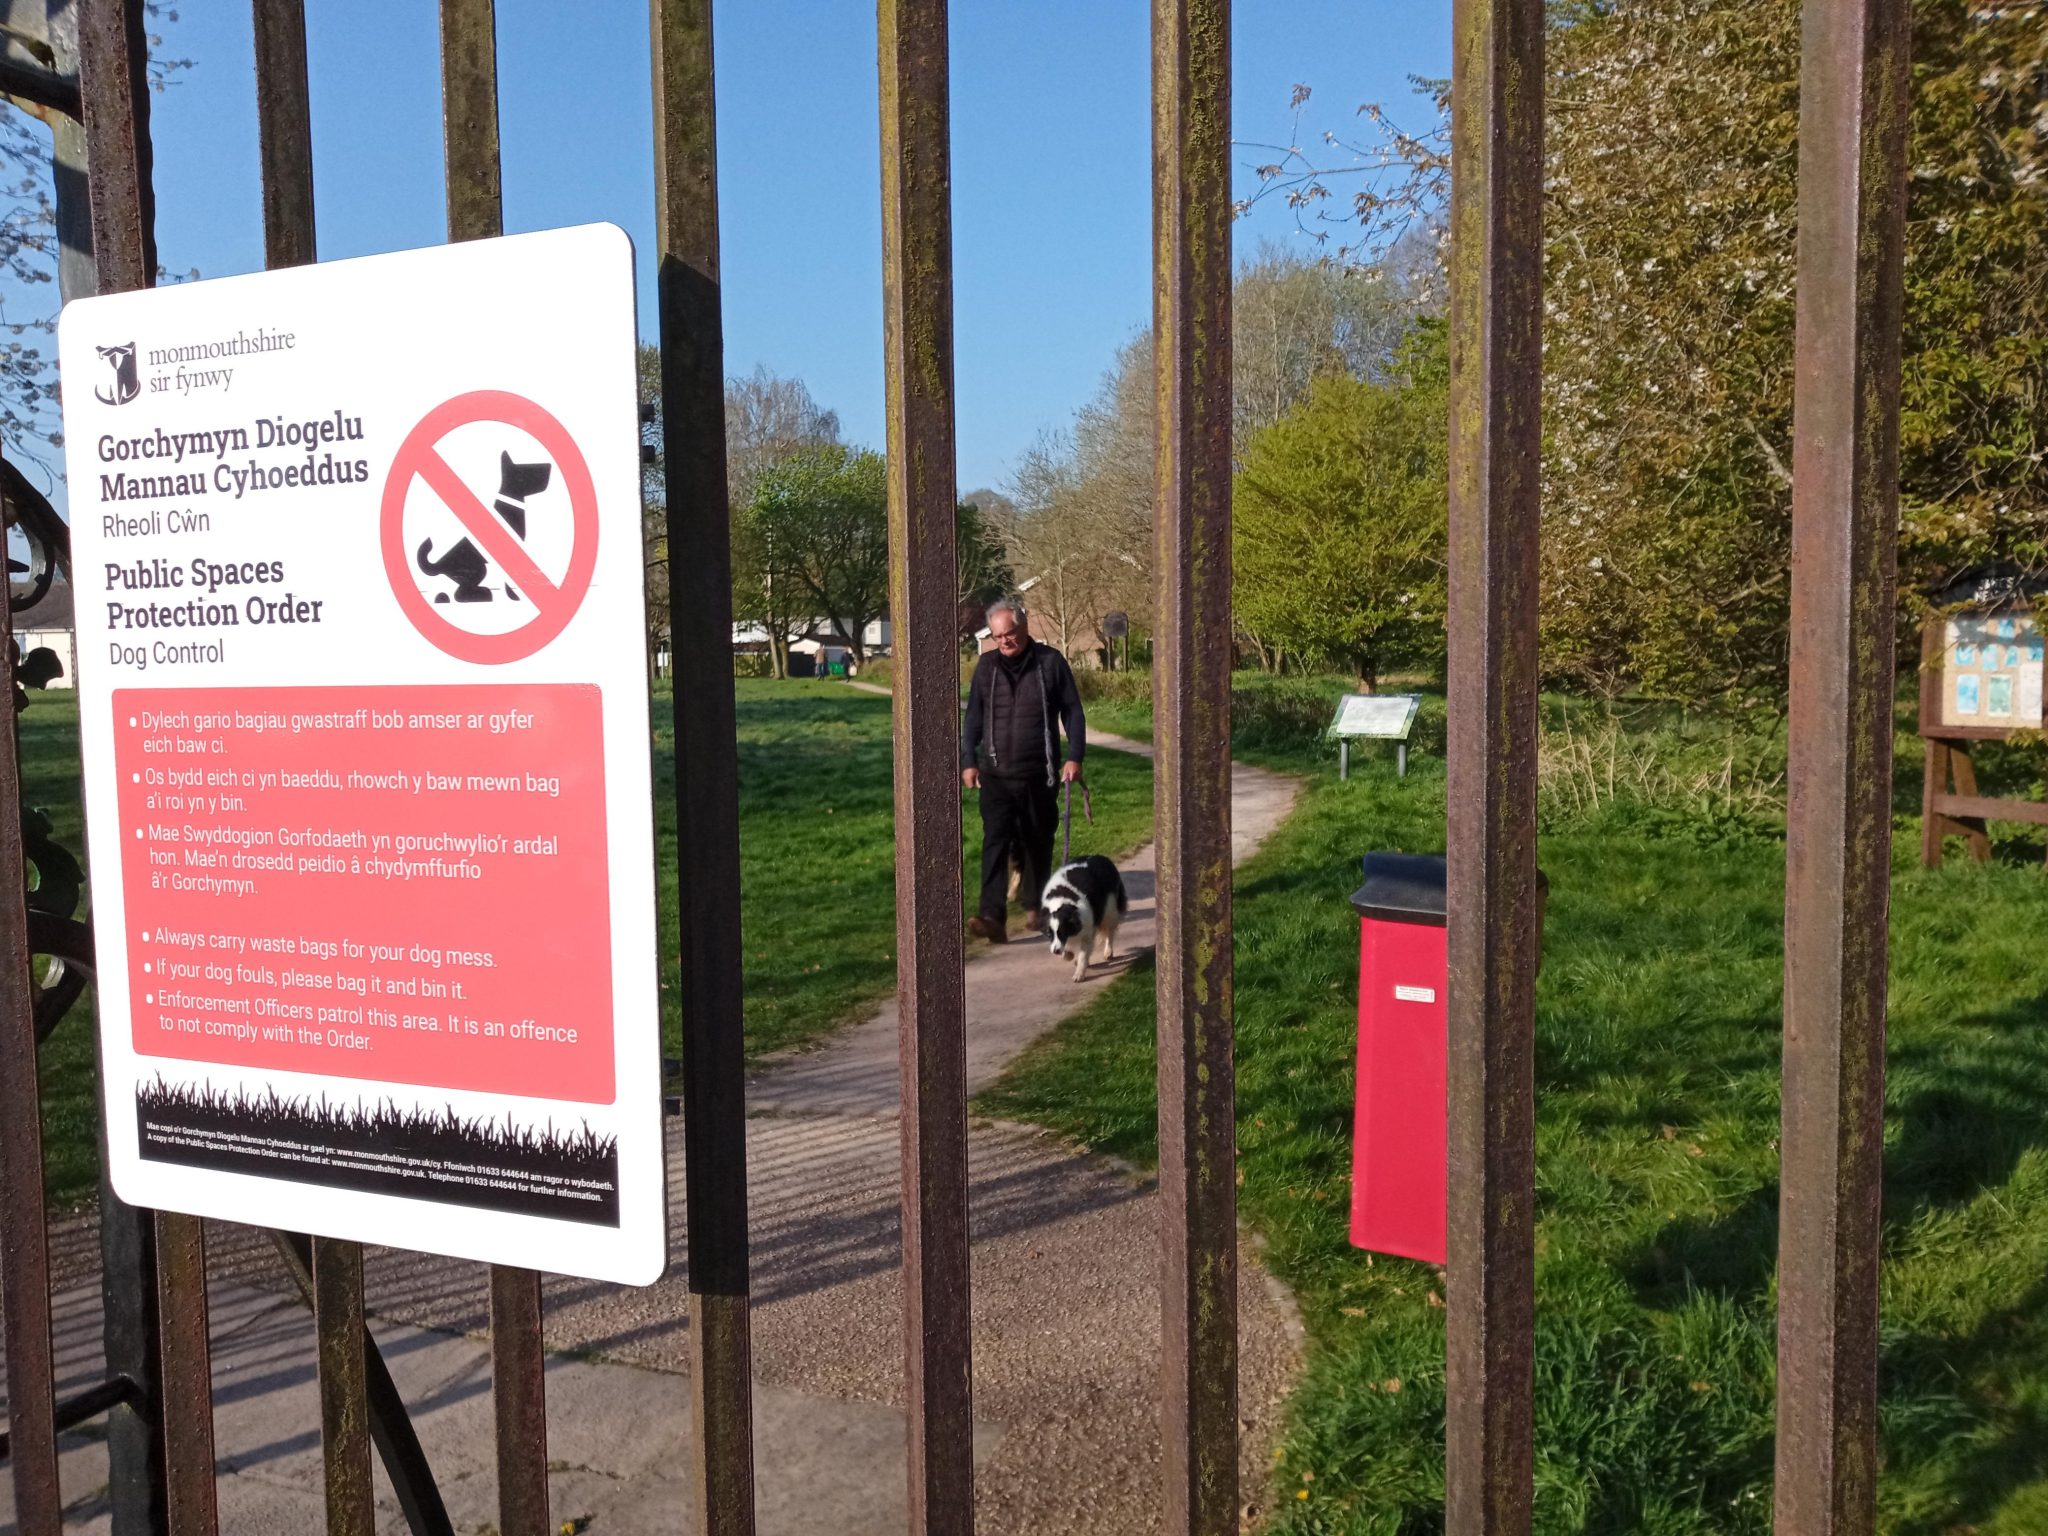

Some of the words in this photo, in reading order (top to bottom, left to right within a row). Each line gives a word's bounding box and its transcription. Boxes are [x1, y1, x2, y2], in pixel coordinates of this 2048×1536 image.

[148, 327, 295, 365] monmouthshire
[150, 370, 171, 392] sir
[175, 366, 233, 396] fynwy
[98, 428, 249, 463] Gorchymyn
[255, 410, 364, 451] Diogelu
[99, 472, 207, 502] Mannau
[213, 454, 368, 499] Cyhoeddus
[102, 510, 160, 537] Rheoli
[167, 508, 210, 533] Cŵn
[104, 558, 183, 590] Public
[191, 558, 284, 592] Spaces
[106, 596, 239, 629] Protection
[245, 592, 322, 624] Order
[109, 642, 146, 670] Dog
[153, 638, 223, 664] Control
[141, 710, 189, 732] Dylech
[193, 711, 231, 732] gario
[235, 710, 286, 733] bagiau
[291, 709, 367, 733] gwastraff
[371, 709, 403, 728] bob
[408, 714, 462, 728] amser
[466, 714, 484, 728] ar
[488, 708, 534, 733] gyfer
[143, 735, 172, 752] eich
[176, 734, 206, 752] baw
[211, 735, 227, 753] ci.
[145, 767, 164, 784] Os
[167, 767, 202, 789] bydd
[207, 767, 237, 785] eich
[241, 769, 254, 786] ci
[258, 773, 276, 791] yn
[280, 768, 343, 790] baeddu,
[347, 769, 408, 789] rhowch
[412, 775, 421, 794] y
[426, 770, 462, 789] baw
[466, 776, 520, 791] mewn
[525, 771, 559, 796] bag
[165, 792, 183, 809] roi
[187, 796, 204, 814] yn
[208, 797, 216, 814] y
[220, 792, 247, 810] bin.
[148, 823, 179, 841] Mae
[183, 824, 273, 848] Swyddogion
[278, 827, 366, 848] Gorfodaeth
[371, 835, 390, 853] yn
[513, 834, 557, 854] ardal
[149, 847, 180, 865] hon.
[231, 850, 293, 870] drosedd
[298, 854, 346, 874] peidio
[350, 855, 360, 873] â
[364, 855, 481, 880] chydymffurfio
[171, 872, 257, 897] Gorchymyn.
[155, 927, 205, 950] Always
[209, 934, 245, 953] carry
[249, 936, 295, 953] waste
[299, 935, 337, 960] bags
[342, 938, 365, 957] for
[369, 945, 405, 963] your
[409, 943, 441, 968] dog
[446, 950, 497, 967] mess.
[156, 957, 166, 974] If
[169, 963, 200, 980] your
[204, 961, 232, 985] dog
[236, 963, 277, 986] fouls,
[281, 967, 332, 989] please
[336, 971, 366, 996] bag
[371, 974, 381, 992] it
[386, 976, 416, 995] and
[421, 977, 446, 997] bin
[451, 980, 466, 999] it.
[158, 989, 250, 1014] Enforcement
[254, 998, 313, 1019] Officers
[318, 1006, 362, 1024] patrol
[367, 1007, 397, 1027] this
[402, 1014, 442, 1031] area.
[448, 1014, 459, 1032] It
[464, 1015, 478, 1034] is
[483, 1021, 504, 1036] an
[509, 1019, 577, 1043] offence
[159, 1014, 173, 1030] to
[177, 1017, 200, 1033] not
[204, 1020, 257, 1042] comply
[261, 1023, 293, 1042] with
[296, 1025, 322, 1045] the
[326, 1029, 373, 1050] Order.
[146, 1121, 159, 1131] Mae
[160, 1124, 173, 1133] copi
[182, 1127, 216, 1139] Gorchymyn
[216, 1131, 240, 1141] Diogelu
[240, 1134, 265, 1145] Mannau
[266, 1138, 302, 1149] Cyhoeddus
[310, 1145, 324, 1153] gael
[443, 1161, 476, 1173] Ffoniwch
[476, 1165, 500, 1176] 01633
[501, 1168, 529, 1179] 644644
[543, 1176, 563, 1185] ragor
[147, 1132, 153, 1141] A
[153, 1134, 167, 1143] copy
[175, 1136, 185, 1144] the
[185, 1138, 205, 1147] Public
[205, 1140, 228, 1150] Spaces
[228, 1143, 260, 1156] Protection
[261, 1148, 279, 1157] Order
[292, 1152, 301, 1161] be
[301, 1153, 320, 1164] found
[428, 1170, 464, 1183] Telephone
[465, 1175, 488, 1186] 01633
[489, 1179, 517, 1190] 644644
[518, 1182, 529, 1192] for
[530, 1184, 555, 1195] further
